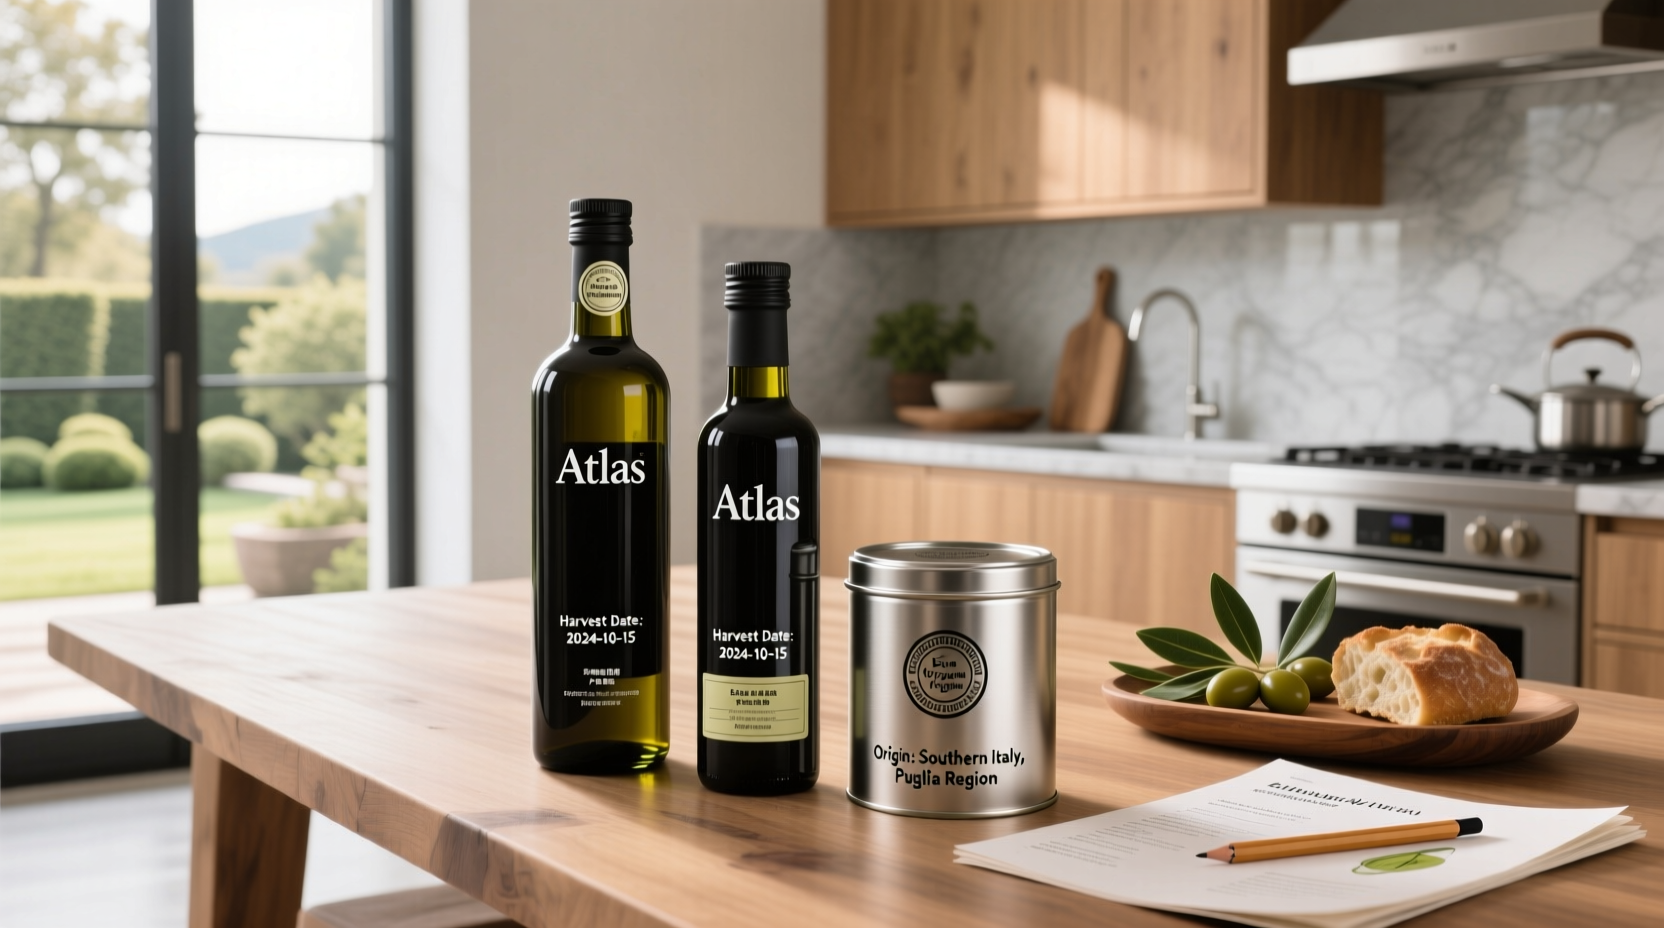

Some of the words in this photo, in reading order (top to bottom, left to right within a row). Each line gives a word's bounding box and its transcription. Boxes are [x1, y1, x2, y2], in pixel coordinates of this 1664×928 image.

[556, 447, 646, 485] Atlas
[712, 484, 800, 521] Atlas
[559, 615, 607, 627] Harvest
[610, 615, 643, 627] Date:
[566, 630, 636, 645] 2024-10-15
[712, 629, 759, 642] Harvest
[762, 629, 794, 642] Date:
[719, 646, 787, 660] 2024-10-15
[873, 744, 915, 766] Origin:
[918, 748, 988, 765] Southern
[991, 748, 1025, 768] Italy,
[895, 768, 941, 789] Puglia
[945, 770, 998, 790] Region
